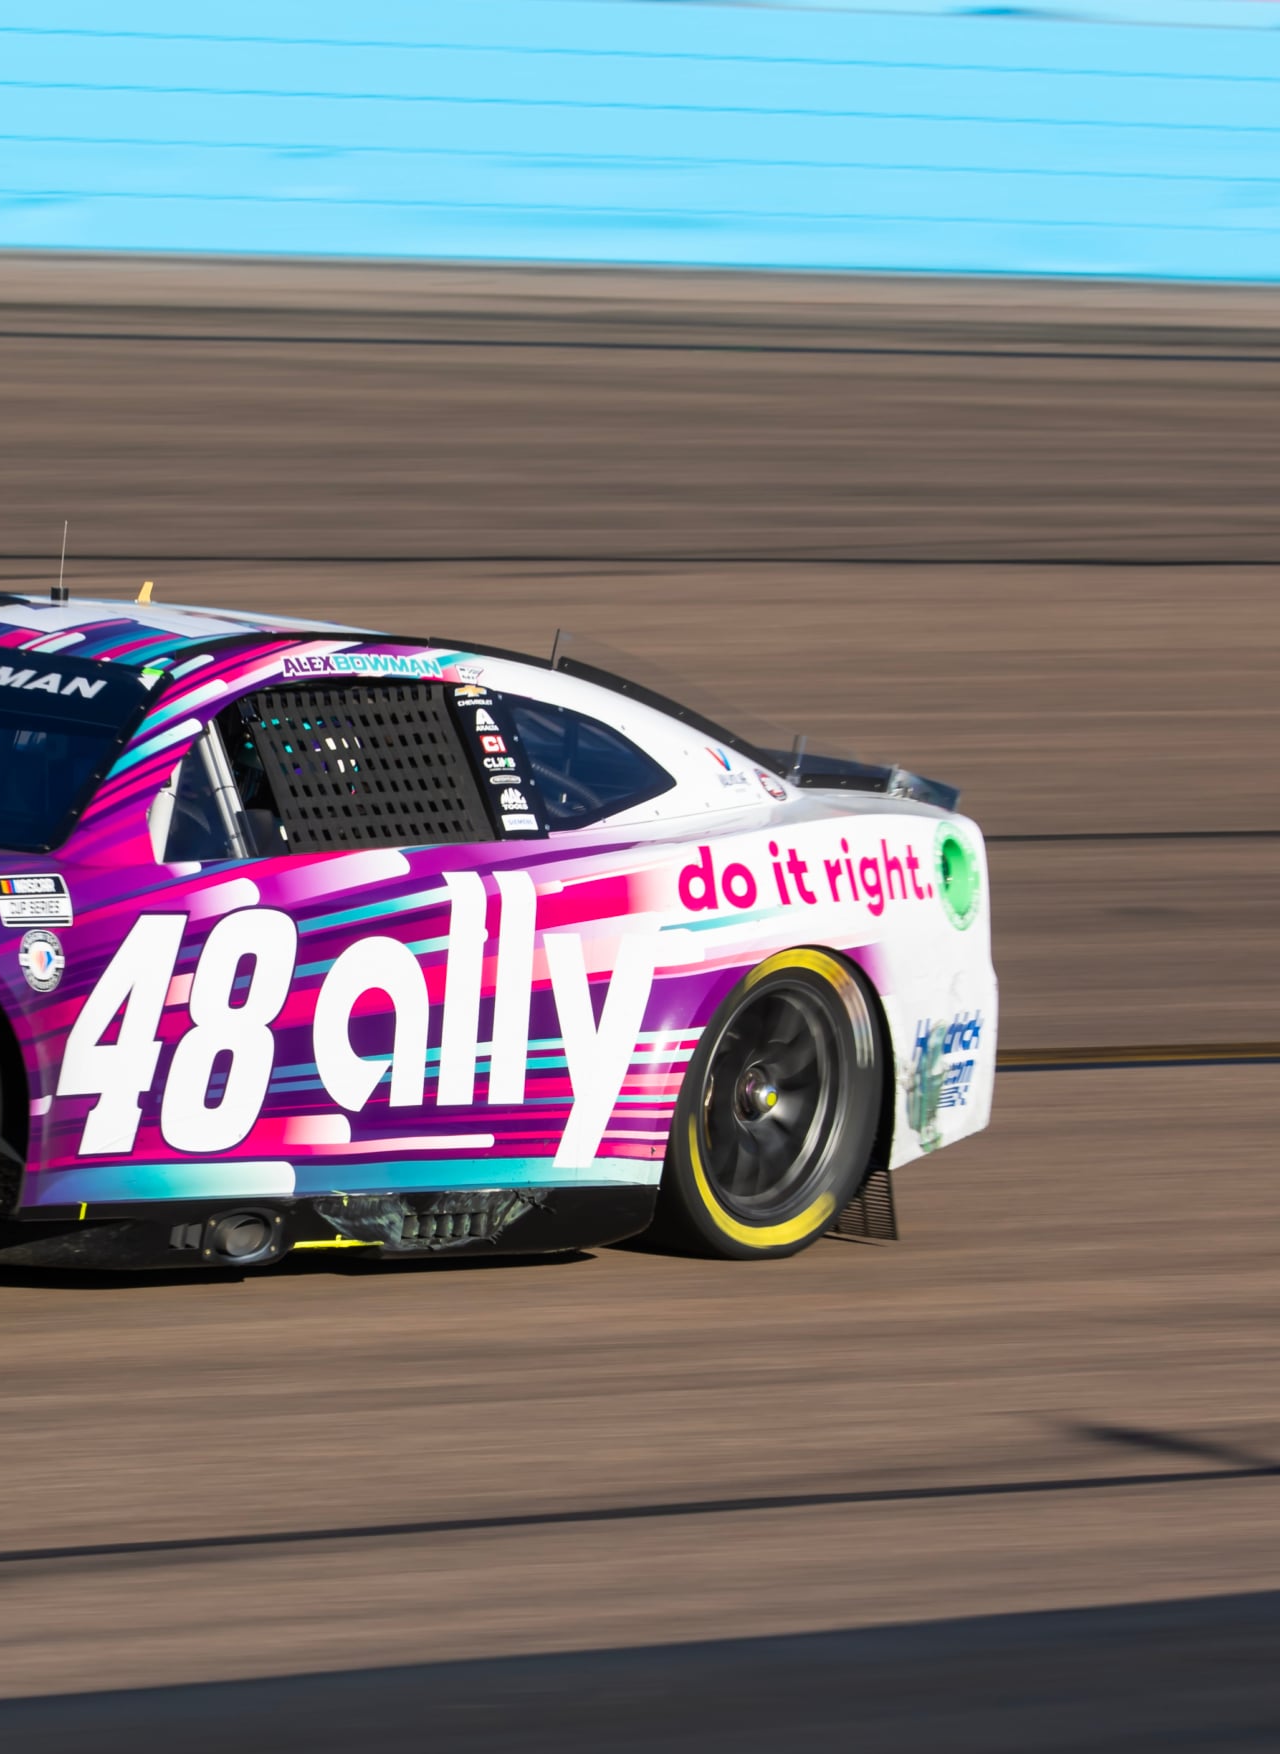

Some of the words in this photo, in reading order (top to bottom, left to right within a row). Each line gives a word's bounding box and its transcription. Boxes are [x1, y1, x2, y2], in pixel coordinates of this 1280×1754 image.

[678, 845, 758, 912] do
[768, 840, 818, 906] it
[822, 837, 934, 917] right.
[56, 908, 298, 1155] 48
[312, 870, 664, 1168] ally
